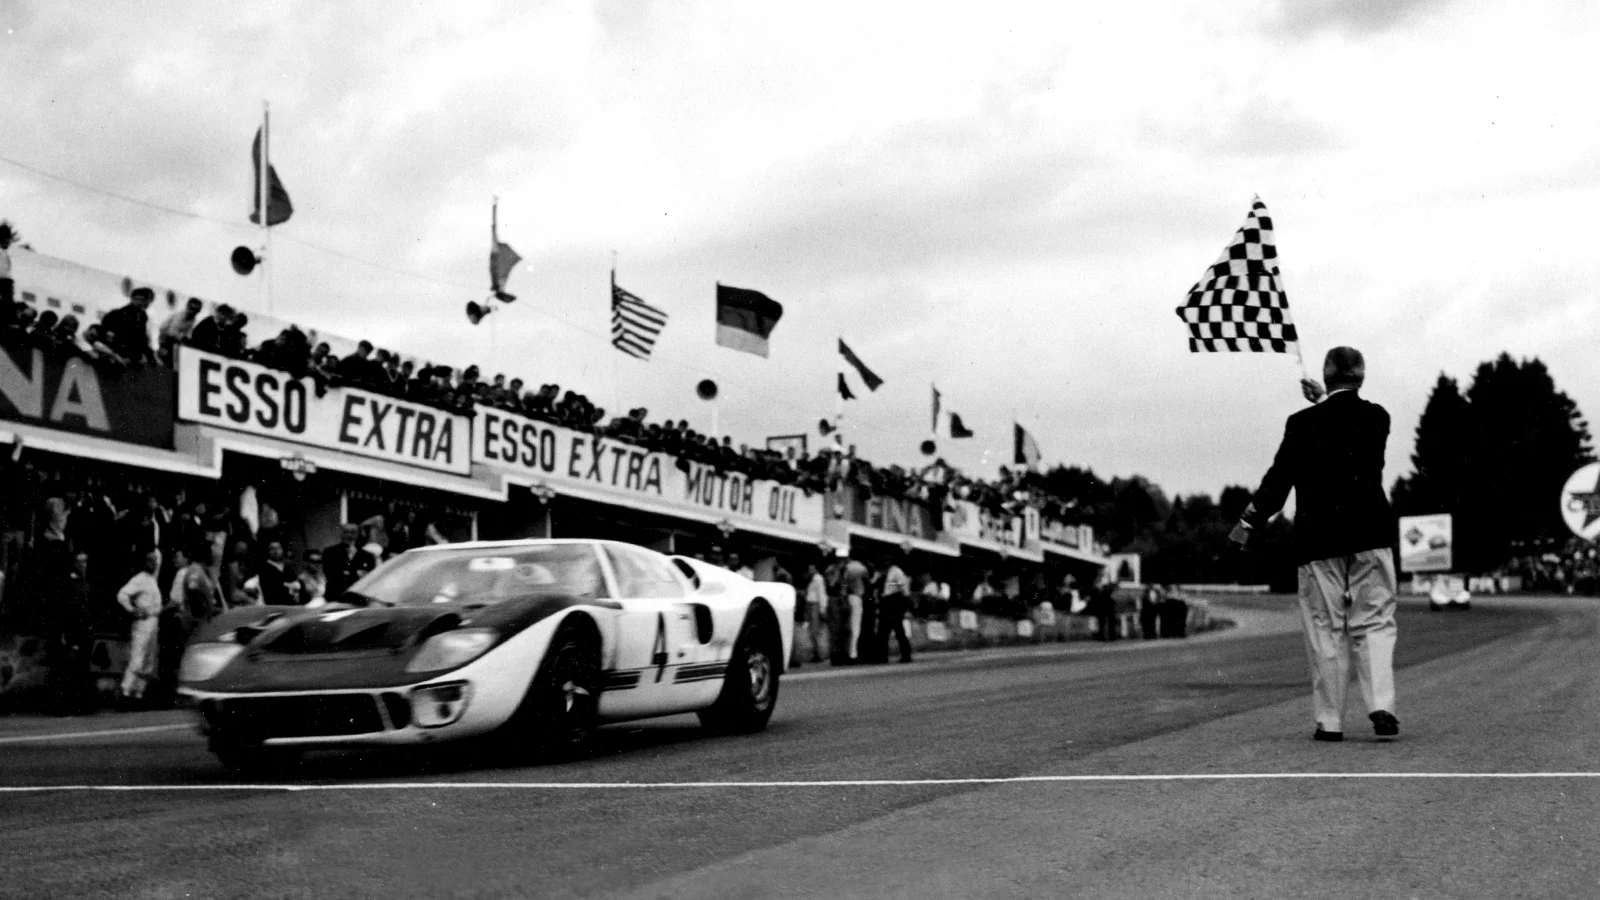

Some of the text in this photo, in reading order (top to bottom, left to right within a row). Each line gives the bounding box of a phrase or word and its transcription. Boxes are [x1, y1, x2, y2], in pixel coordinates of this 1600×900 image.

[198, 358, 453, 465] ESSO EXTRA
[484, 413, 797, 525] ESSO EXTRA MOTOR OIL
[864, 495, 924, 538] FINA
[650, 610, 669, 684] 4
